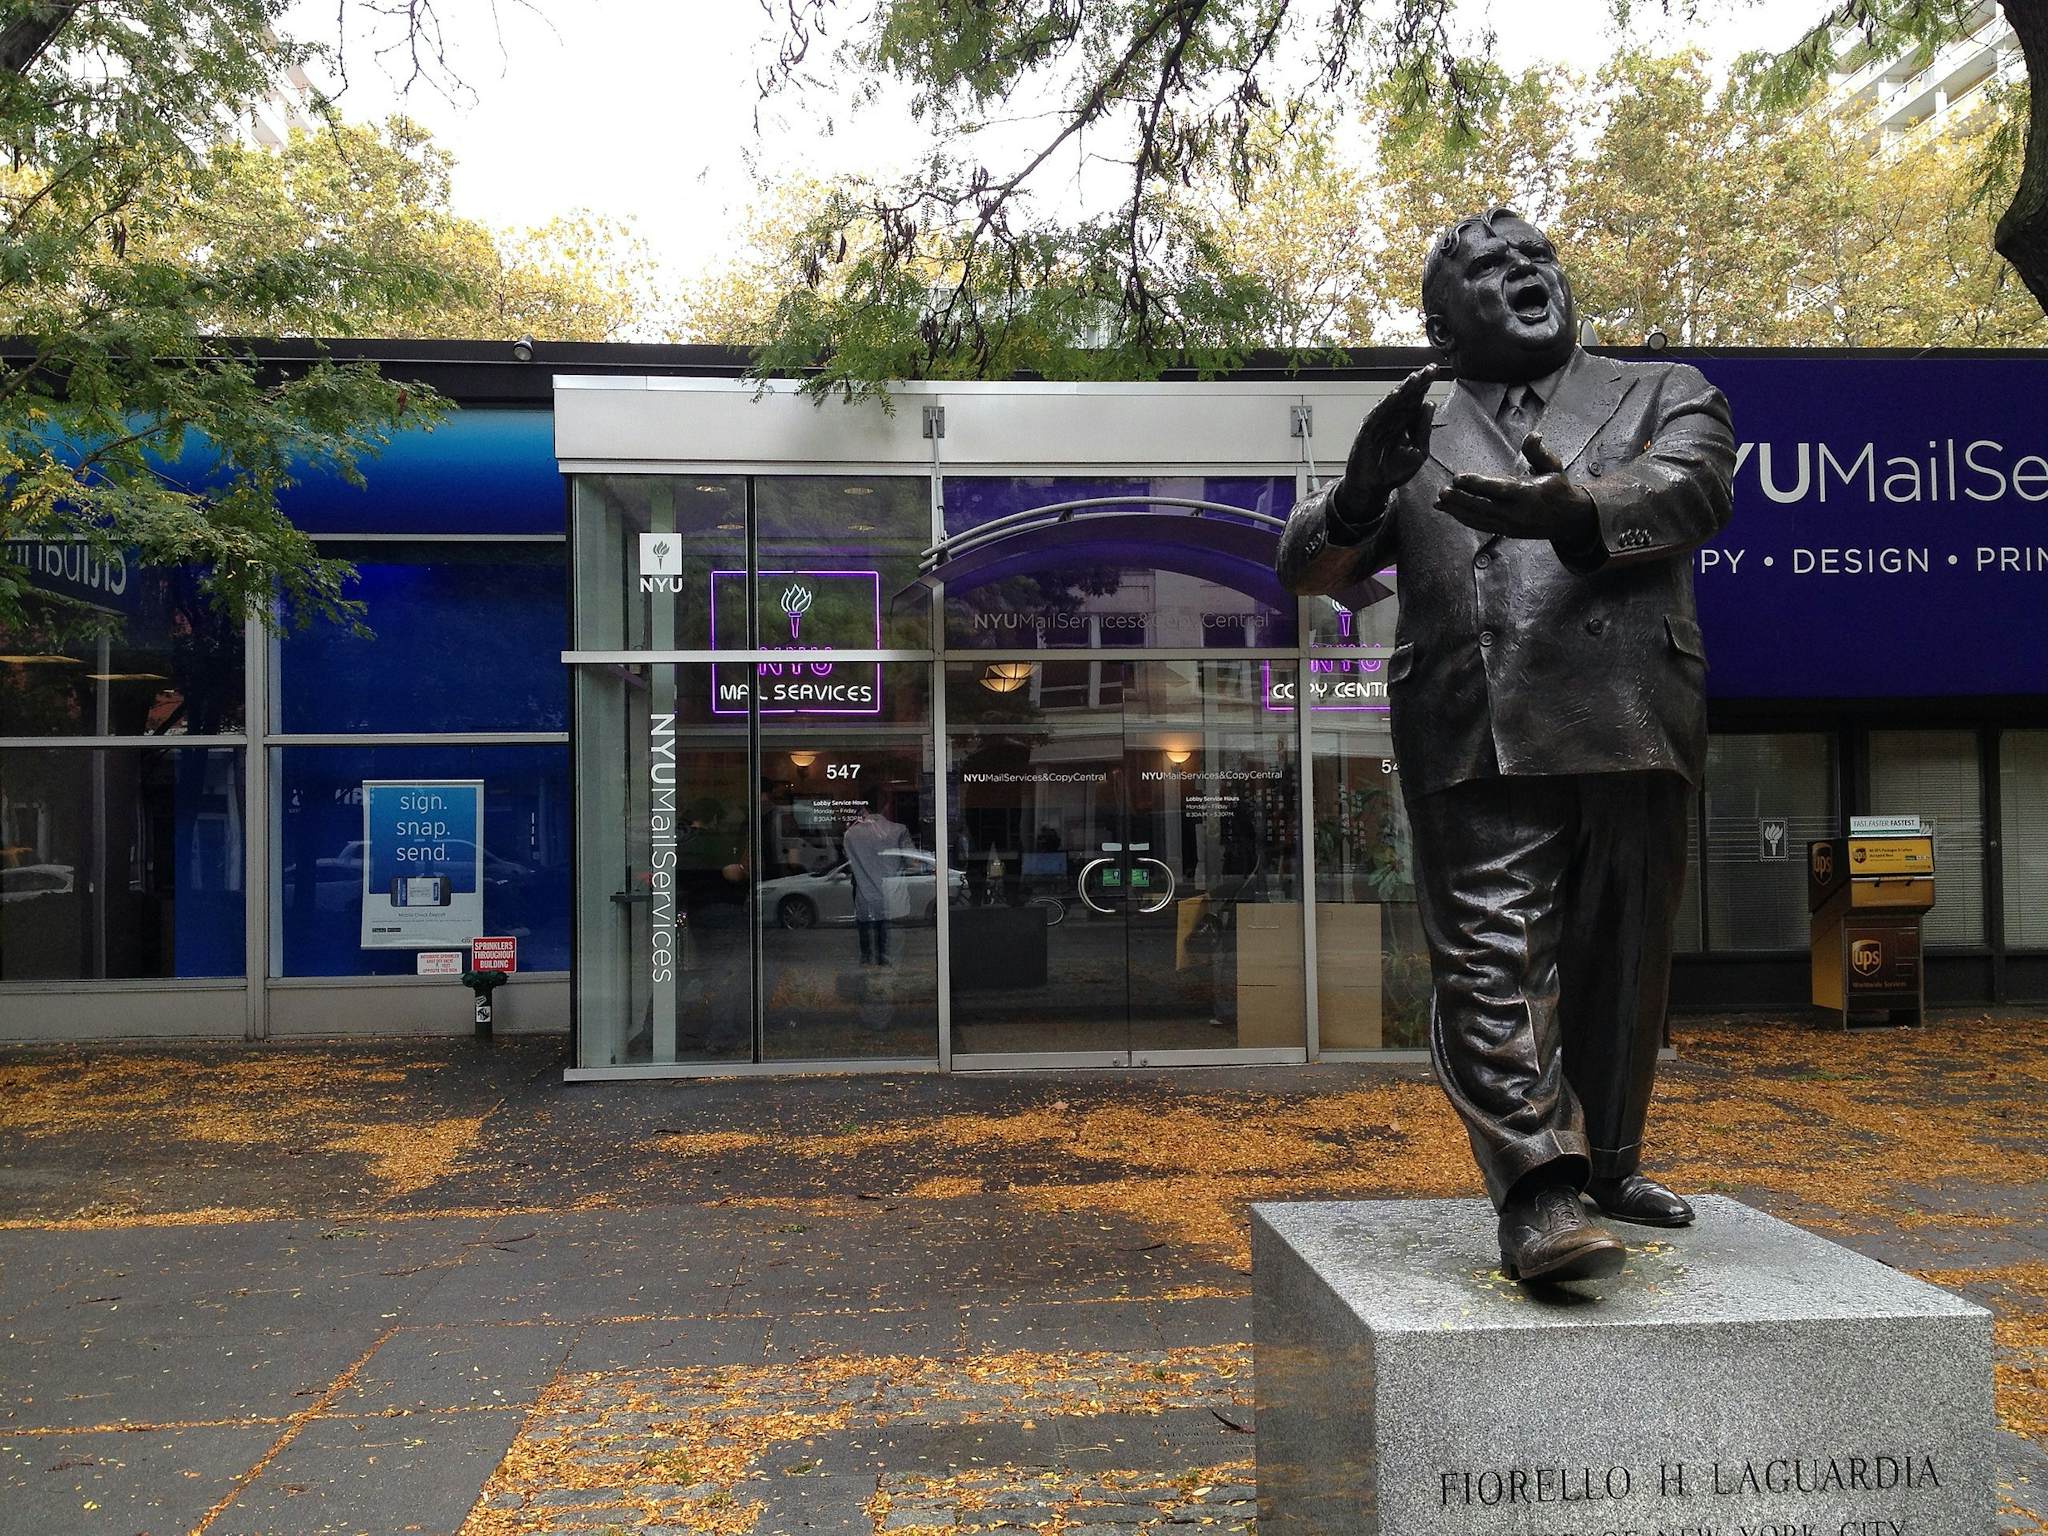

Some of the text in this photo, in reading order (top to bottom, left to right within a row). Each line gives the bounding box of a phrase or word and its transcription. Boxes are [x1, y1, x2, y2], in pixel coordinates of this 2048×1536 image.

[1692, 549, 1745, 574] PY
[1793, 548, 1929, 574] DESIGN
[639, 577, 683, 593] NYU
[719, 684, 872, 702] MA SERVICES
[826, 764, 861, 779] 547
[400, 792, 448, 814] sign.
[396, 821, 451, 838] snap.
[396, 842, 450, 861] send.
[650, 713, 678, 983] NYUMailServices
[1814, 855, 1832, 880] ups
[473, 950, 514, 959] THROUGHOUT
[474, 942, 513, 951] SPRINKLERS
[480, 960, 508, 968] BUILDING
[1855, 950, 1880, 971] ups
[1441, 1465, 1631, 1506] FIORELLO
[1713, 1454, 1942, 1495] LAGUARDIA
